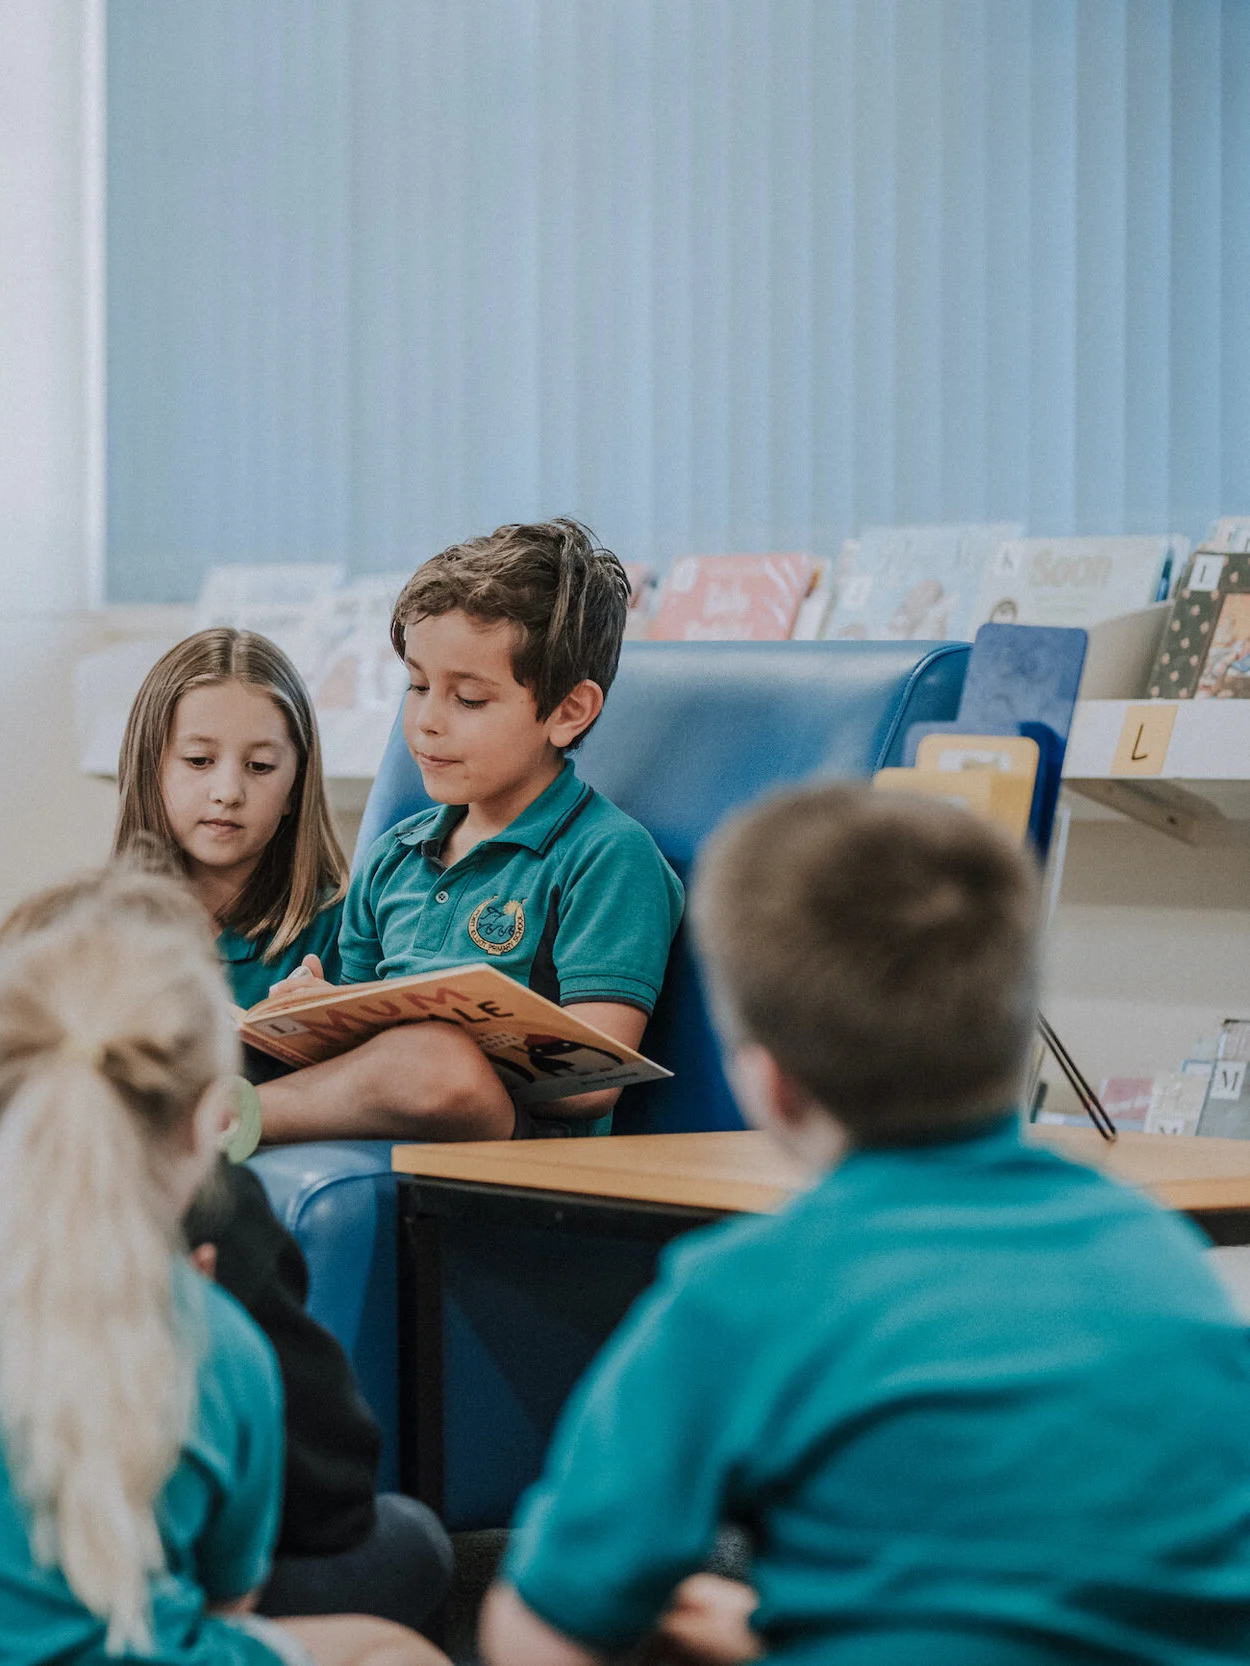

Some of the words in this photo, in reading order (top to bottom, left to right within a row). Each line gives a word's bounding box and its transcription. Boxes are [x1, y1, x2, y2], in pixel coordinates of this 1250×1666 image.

[1131, 722, 1149, 761] L
[488, 940, 515, 952] PRIMARY
[513, 916, 525, 943] SCHOOL
